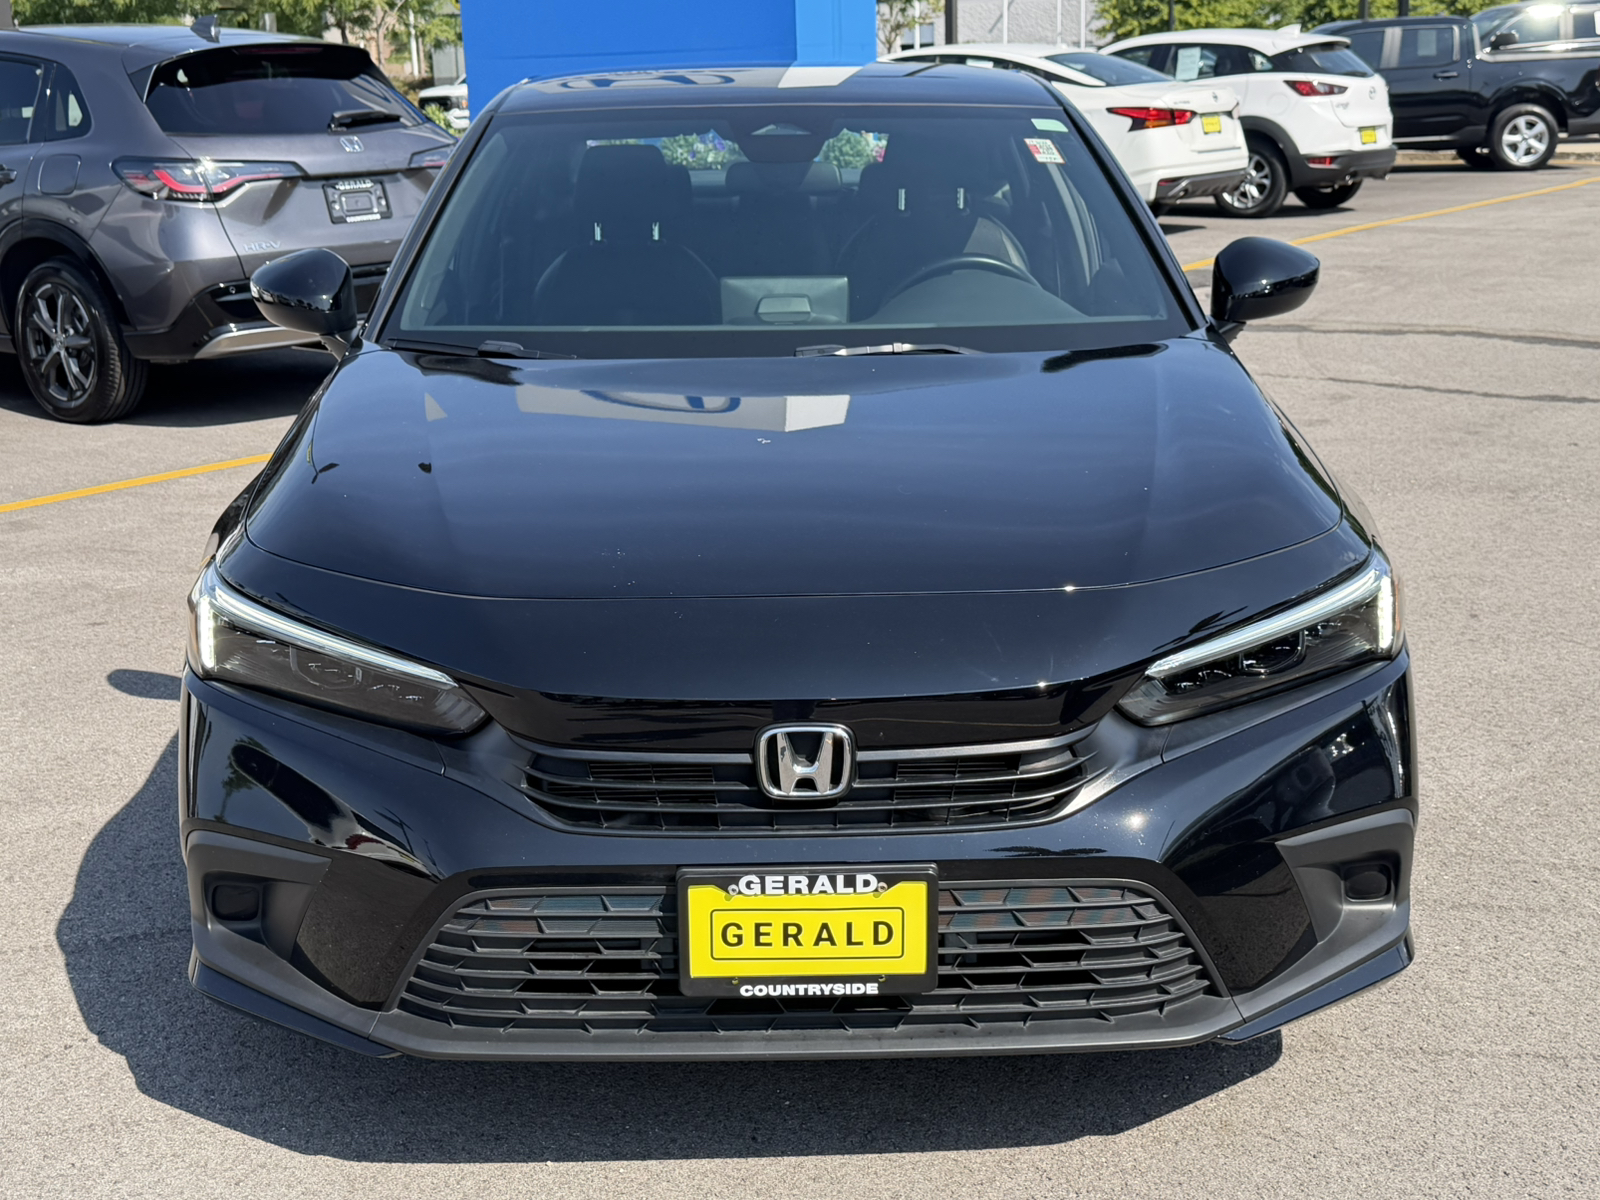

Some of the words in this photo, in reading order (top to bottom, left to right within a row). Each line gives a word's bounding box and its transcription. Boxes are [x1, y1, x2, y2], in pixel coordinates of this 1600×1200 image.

[738, 874, 878, 895] GERALD
[721, 921, 894, 947] GERALD
[739, 983, 879, 996] COUNTRYSIDE
